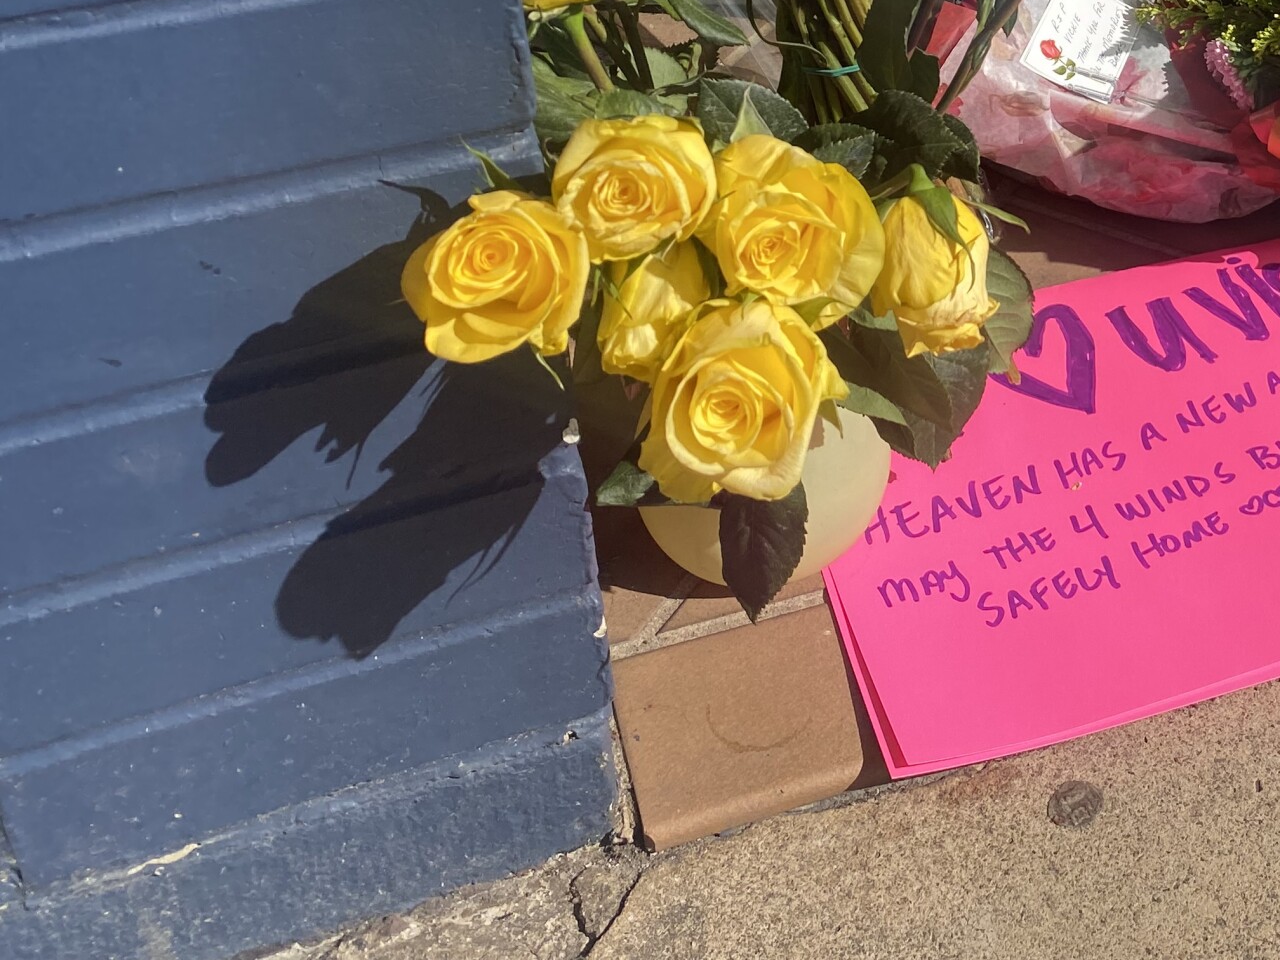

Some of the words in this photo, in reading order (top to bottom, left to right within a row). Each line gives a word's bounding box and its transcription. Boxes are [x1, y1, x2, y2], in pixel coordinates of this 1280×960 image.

[1061, 13, 1081, 44] VICKIE
[1076, 36, 1092, 64] THANK
[1092, 1, 1105, 19] FOR
[864, 464, 1042, 545] HEAVEN
[1053, 440, 1127, 490] HAS
[1140, 422, 1168, 451] A
[1176, 382, 1257, 434] NEW
[876, 560, 971, 608] MAY
[982, 526, 1057, 570] THE
[1069, 504, 1110, 539] 4
[1114, 461, 1237, 521] WINDS
[976, 555, 1122, 628] SAFELY
[1130, 511, 1230, 570] HOME
